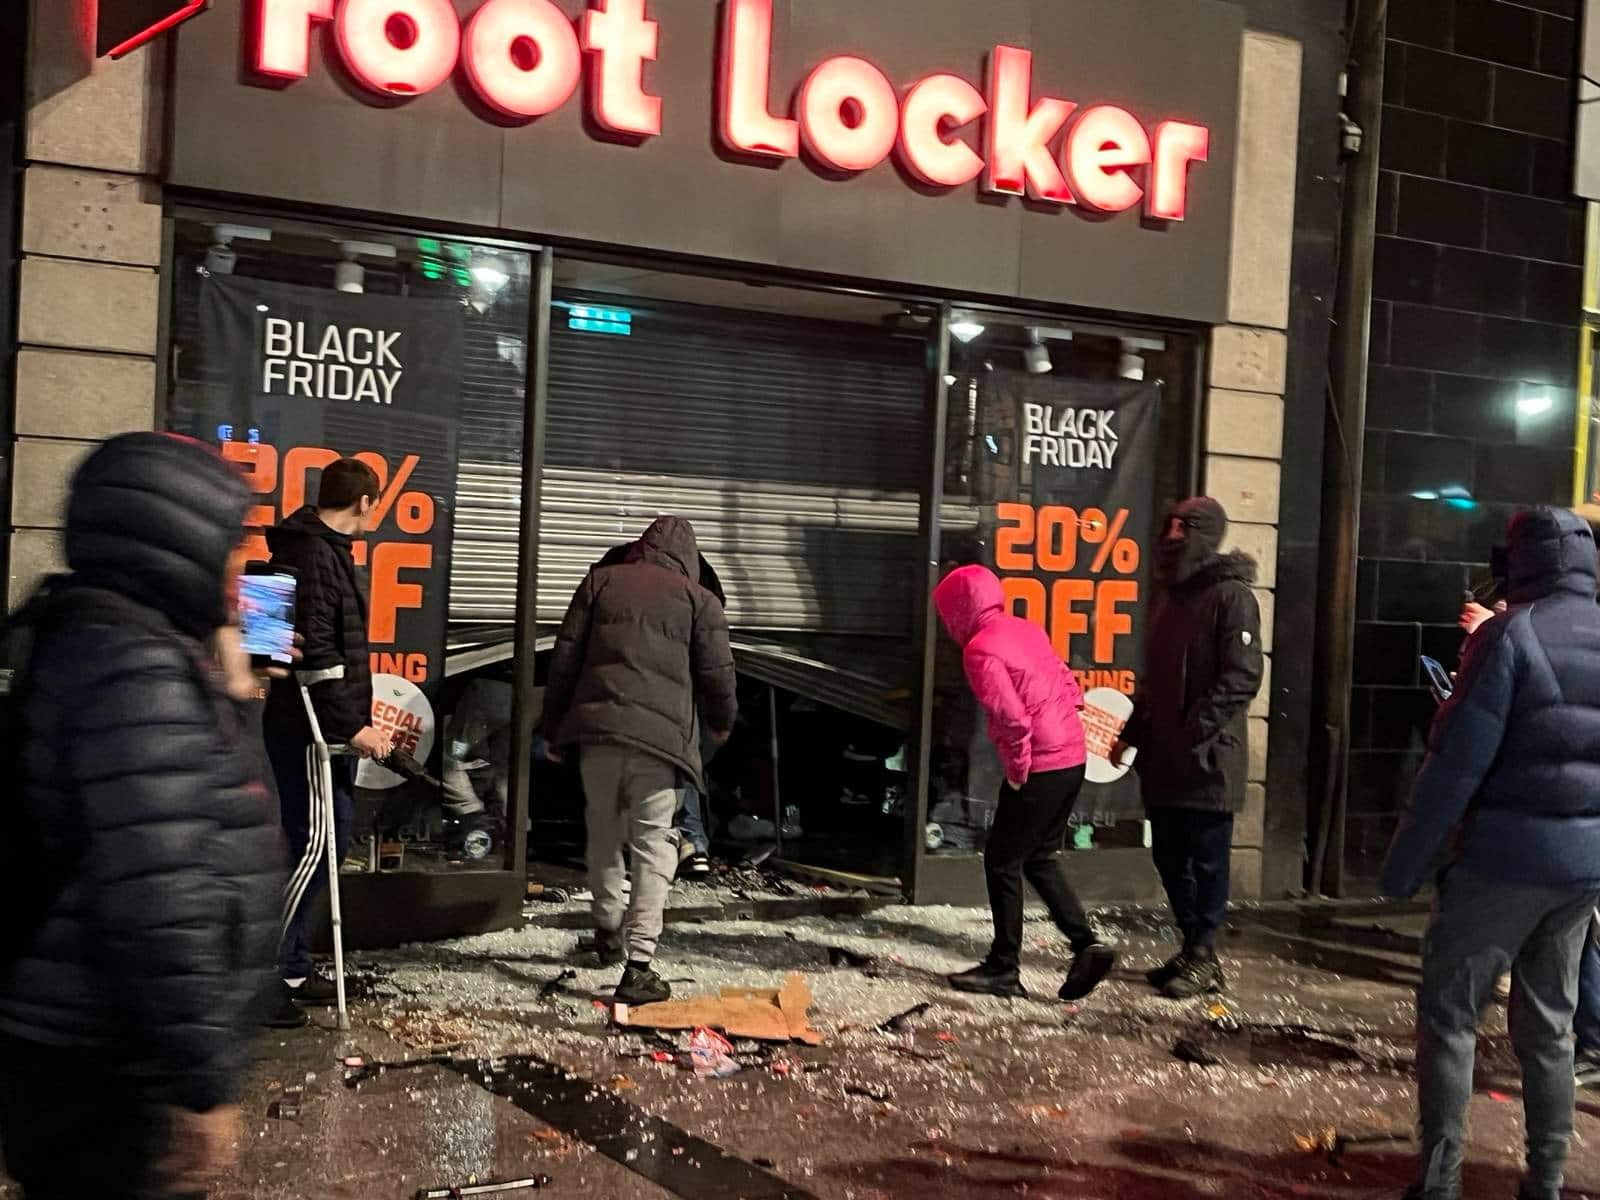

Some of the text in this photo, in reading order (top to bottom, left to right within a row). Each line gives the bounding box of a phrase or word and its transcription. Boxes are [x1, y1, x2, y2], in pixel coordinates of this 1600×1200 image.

[723, 0, 1209, 221] Locker
[263, 317, 403, 369] BLACK
[262, 359, 403, 405] FRIDAY
[1023, 402, 1118, 441] BLACK
[1022, 435, 1119, 470] FRIDAY
[995, 502, 1139, 575] 20%
[372, 699, 424, 735] ECIAL
